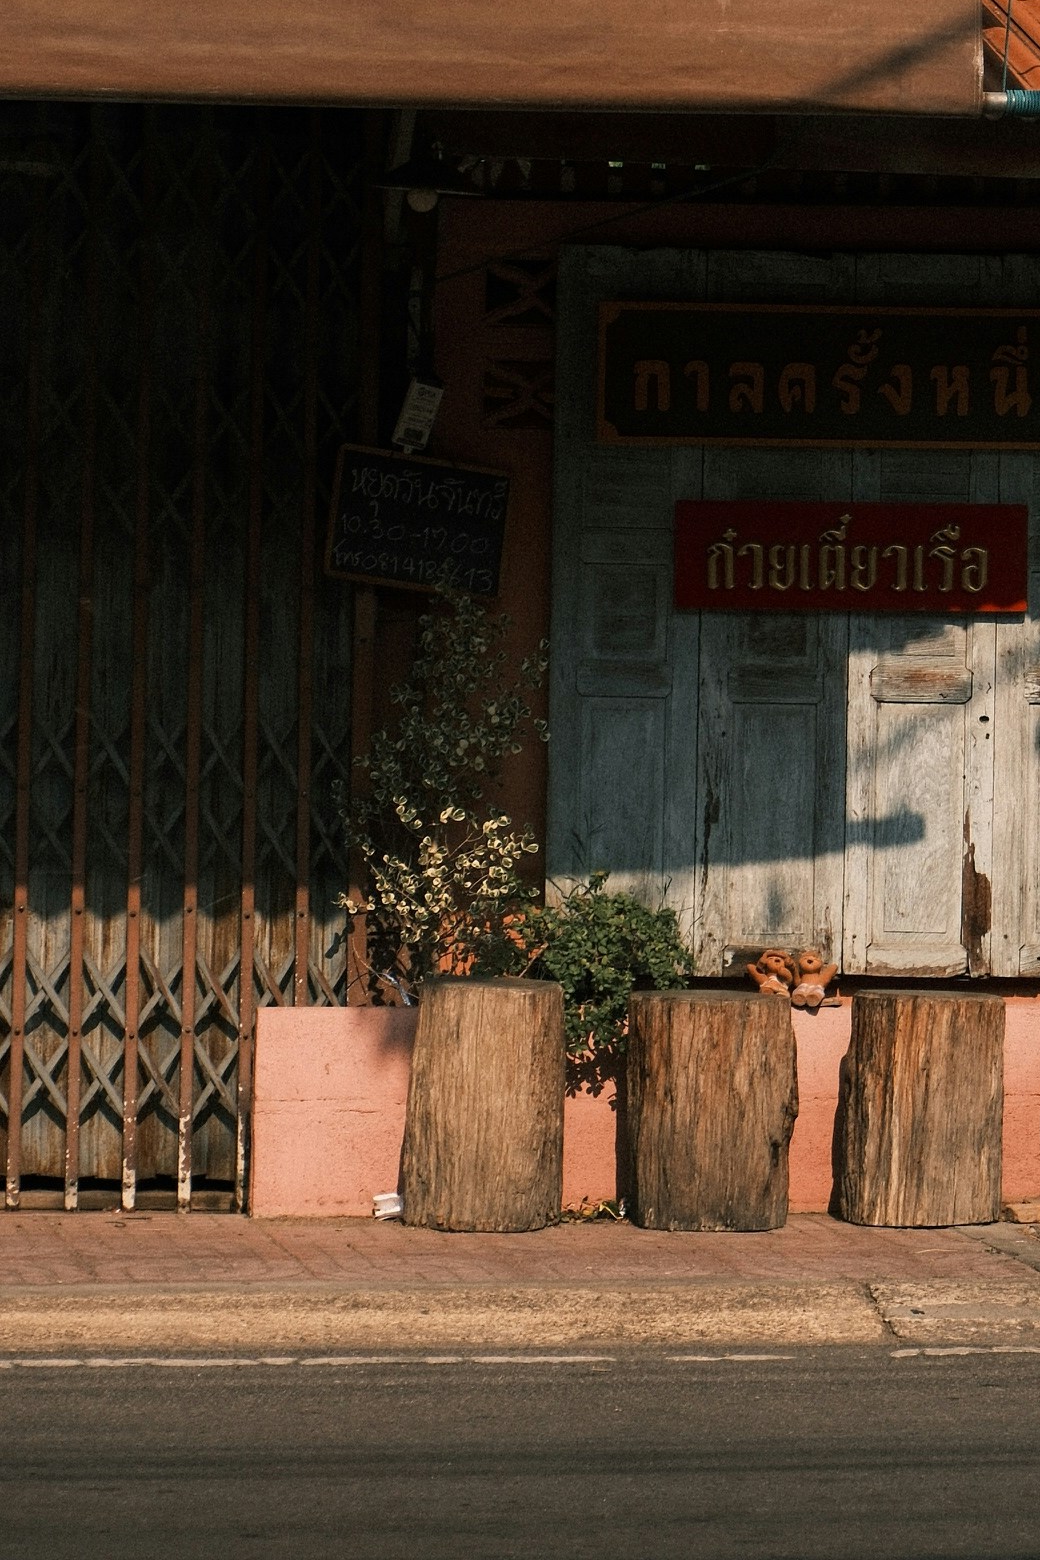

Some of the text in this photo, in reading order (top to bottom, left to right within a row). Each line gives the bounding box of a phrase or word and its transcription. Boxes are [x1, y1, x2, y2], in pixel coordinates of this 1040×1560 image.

[706, 513, 988, 592] ก๋วยเตี๋ยวเรือ
